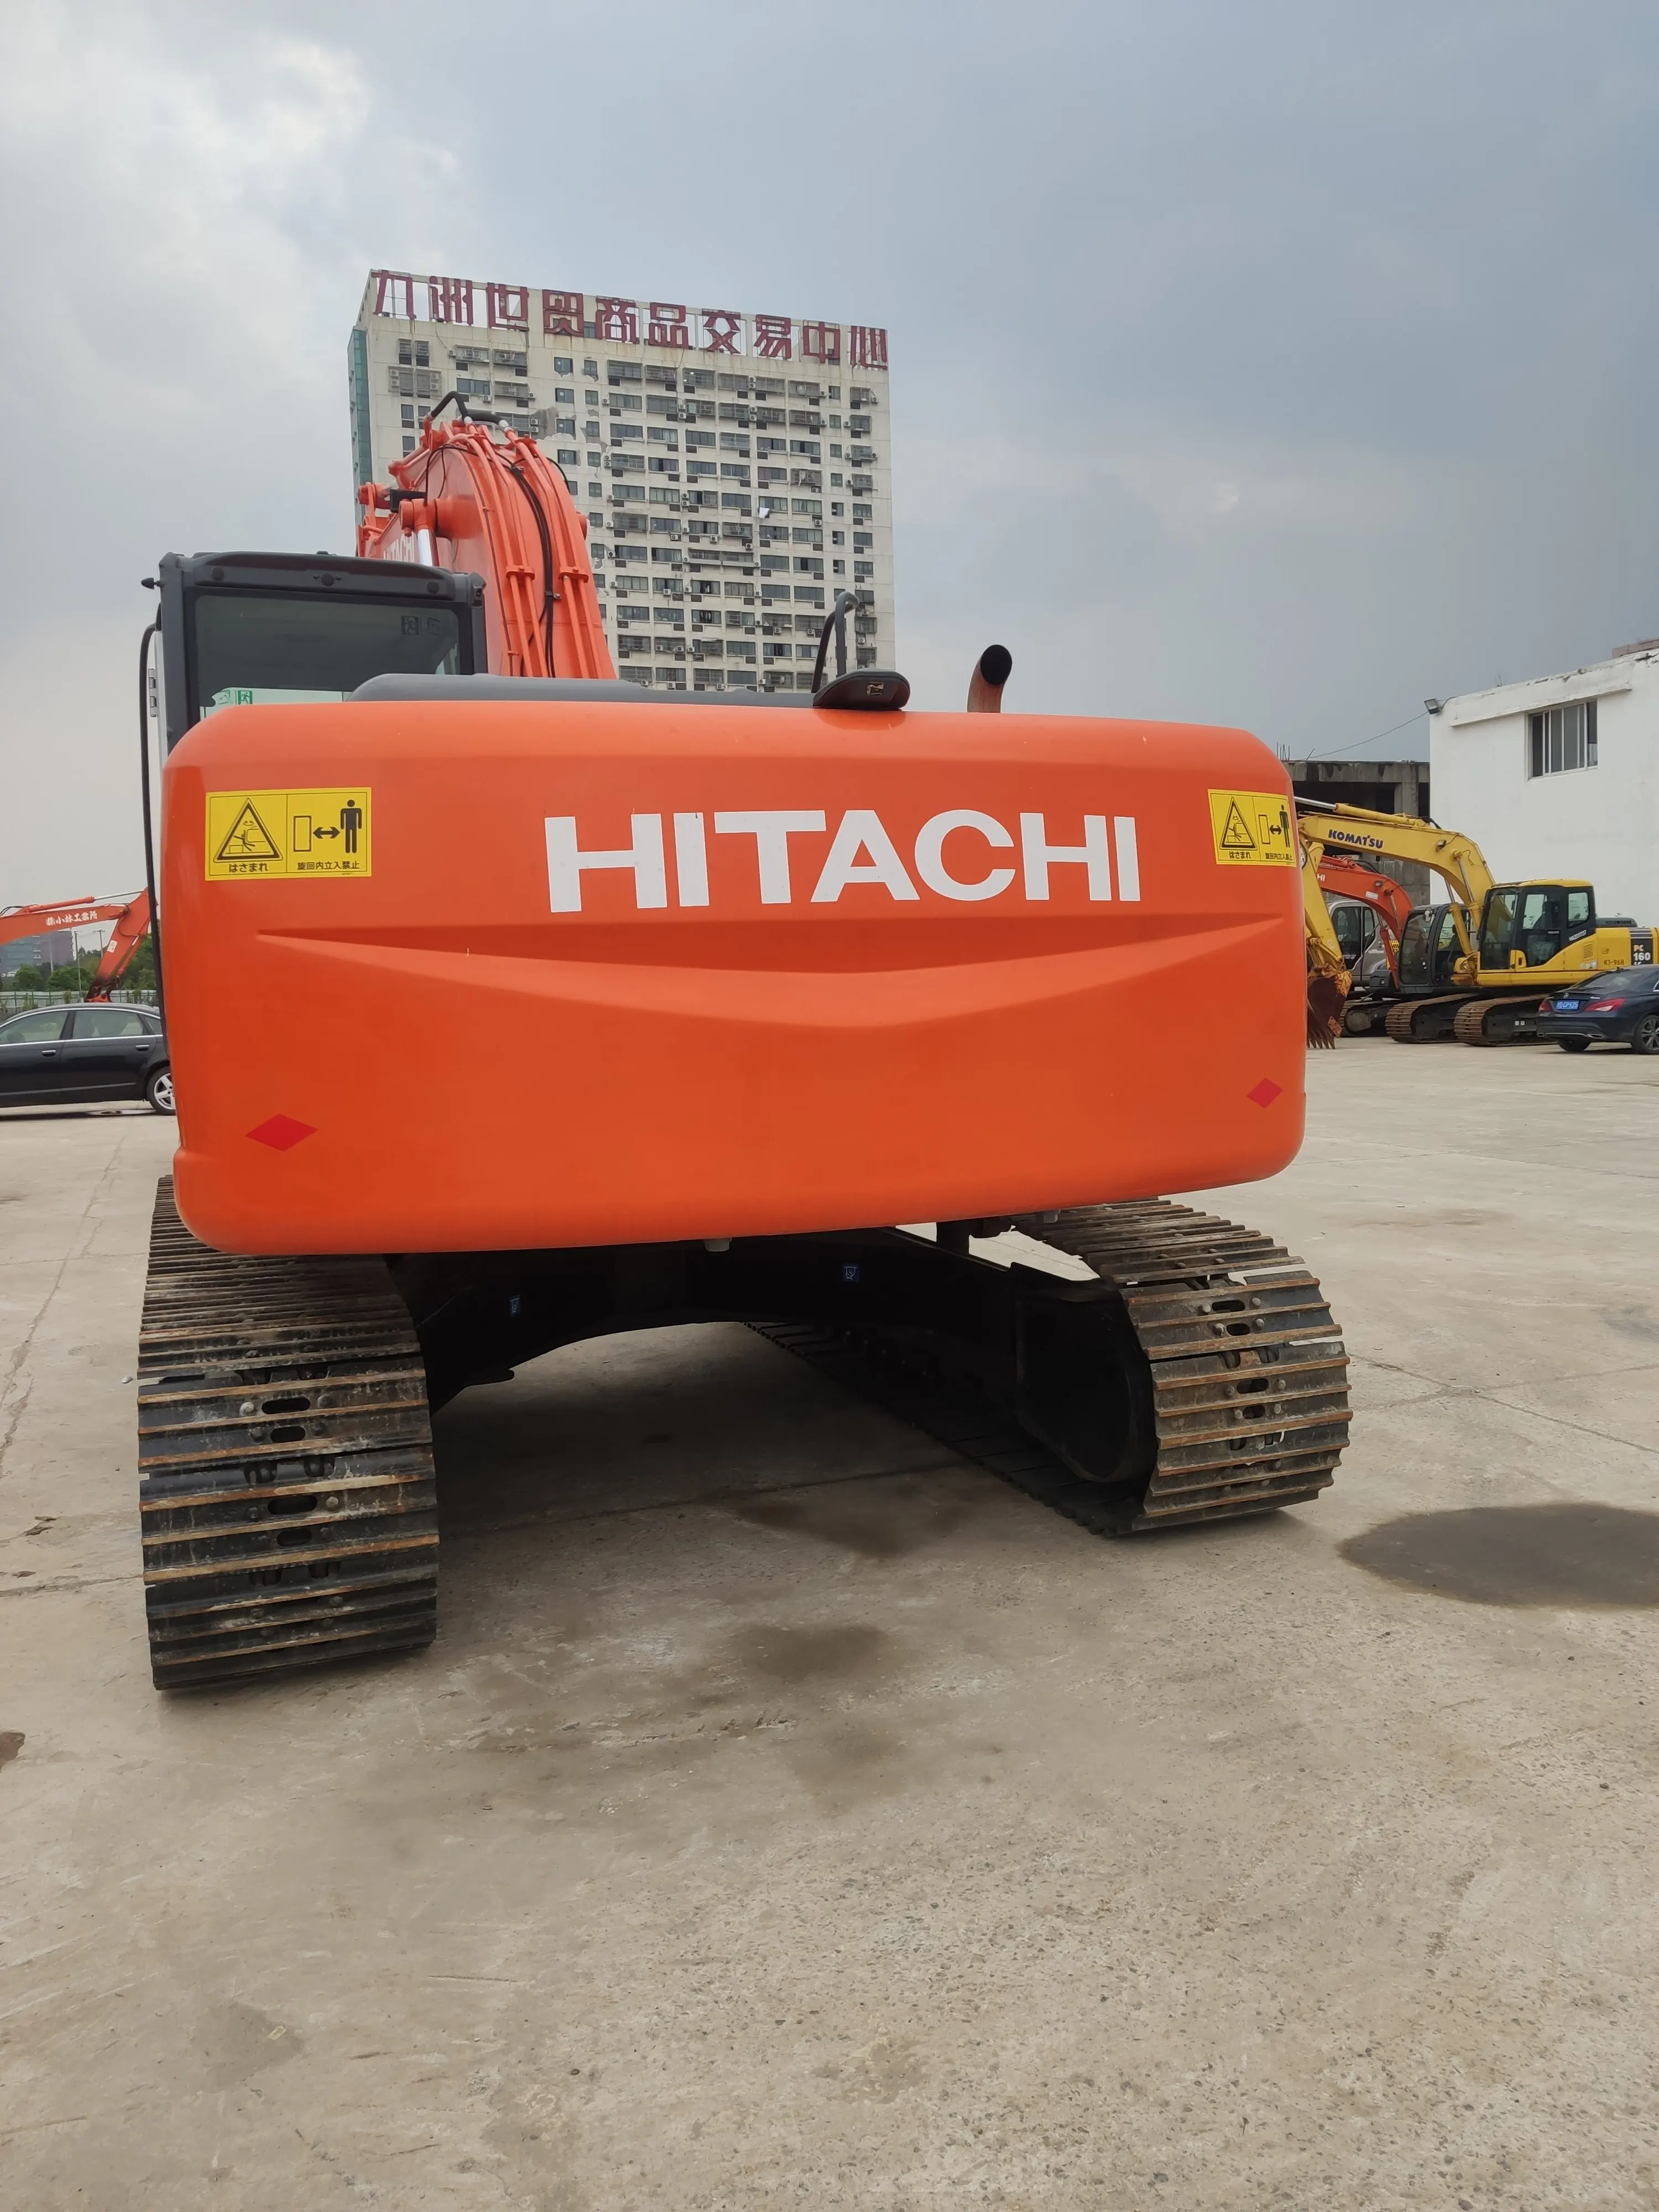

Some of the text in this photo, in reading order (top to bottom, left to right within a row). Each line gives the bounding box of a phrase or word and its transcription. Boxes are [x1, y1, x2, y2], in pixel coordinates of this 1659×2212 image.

[1328, 829, 1384, 849] KOMATSU
[229, 863, 269, 873] はさまれ
[545, 809, 1141, 913] HITACHI
[1633, 952, 1651, 961] 160
